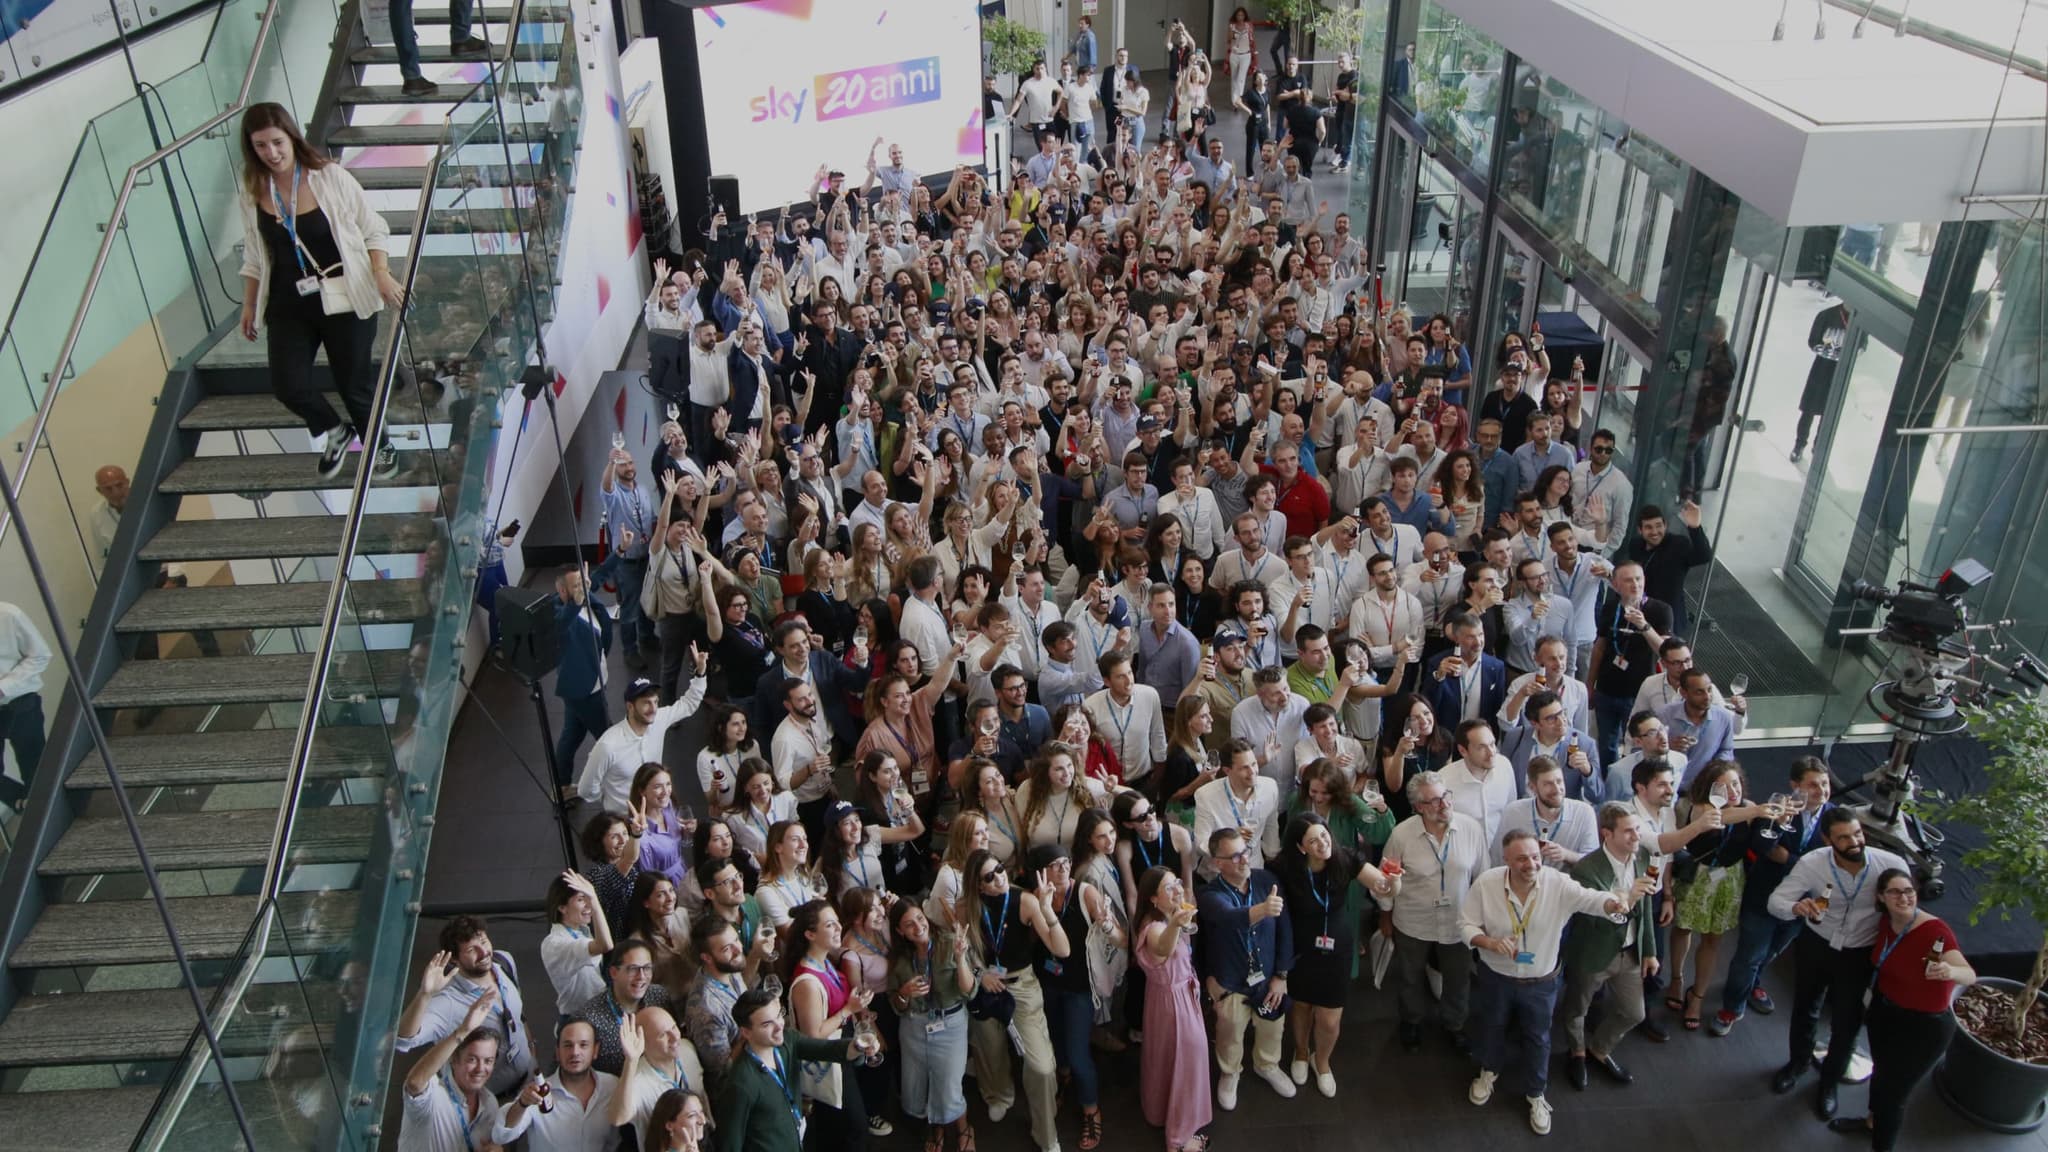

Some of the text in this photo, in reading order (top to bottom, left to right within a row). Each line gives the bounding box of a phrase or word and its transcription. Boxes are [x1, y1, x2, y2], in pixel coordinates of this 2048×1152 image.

[750, 60, 936, 124] sky 20 anni
